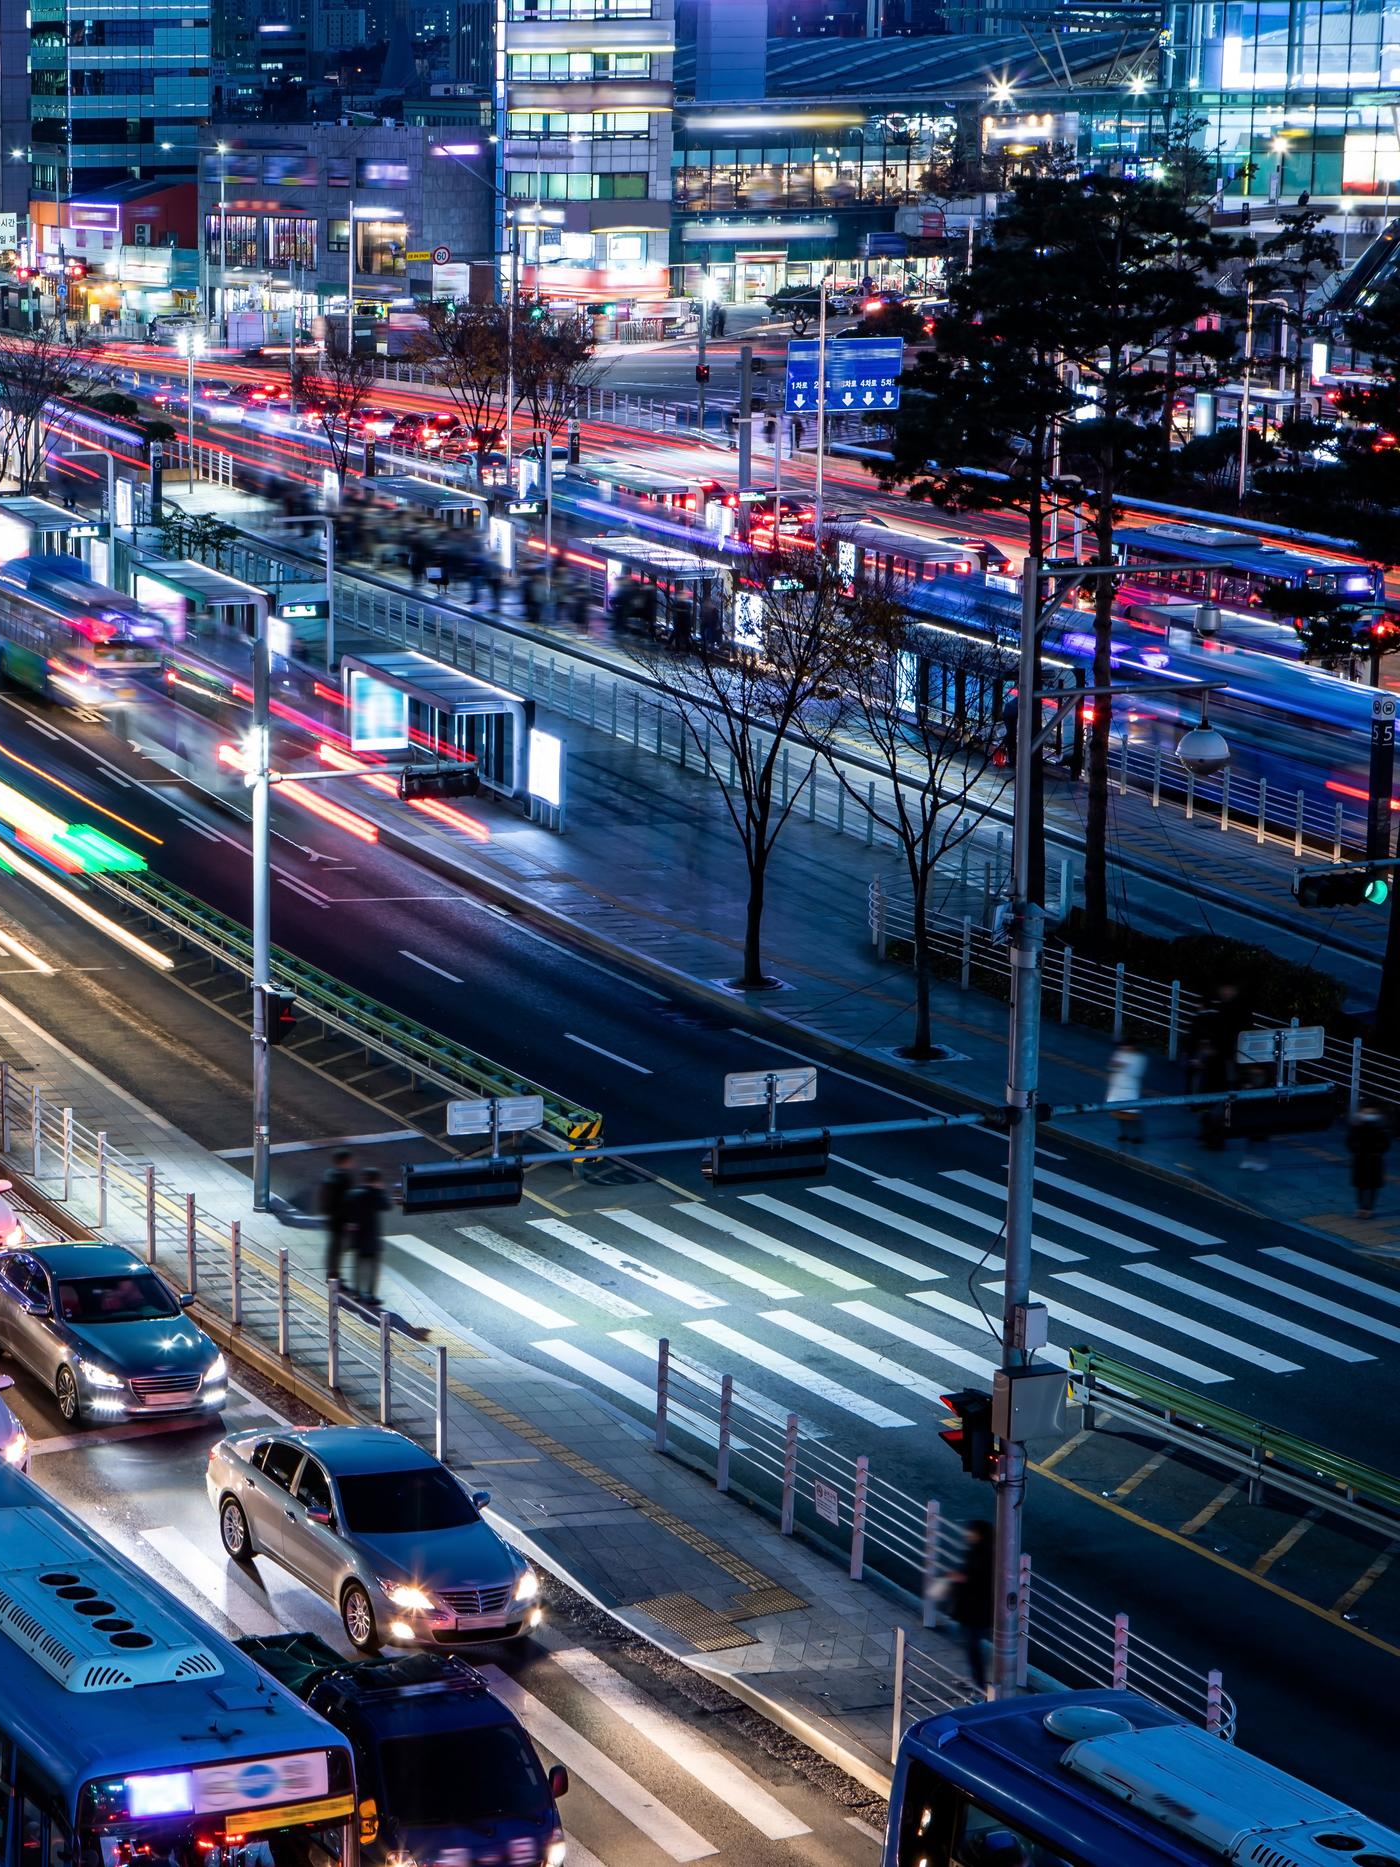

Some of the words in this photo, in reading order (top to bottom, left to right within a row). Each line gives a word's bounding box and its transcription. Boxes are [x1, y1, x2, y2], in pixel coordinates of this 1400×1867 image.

[436, 251, 447, 261] 60
[791, 381, 808, 390] 1차로
[813, 380, 831, 390] 2로
[860, 379, 878, 388] 4차로
[572, 436, 579, 445] 4
[367, 446, 374, 456] 5
[154, 459, 162, 469] 6
[1383, 725, 1393, 741] 5
